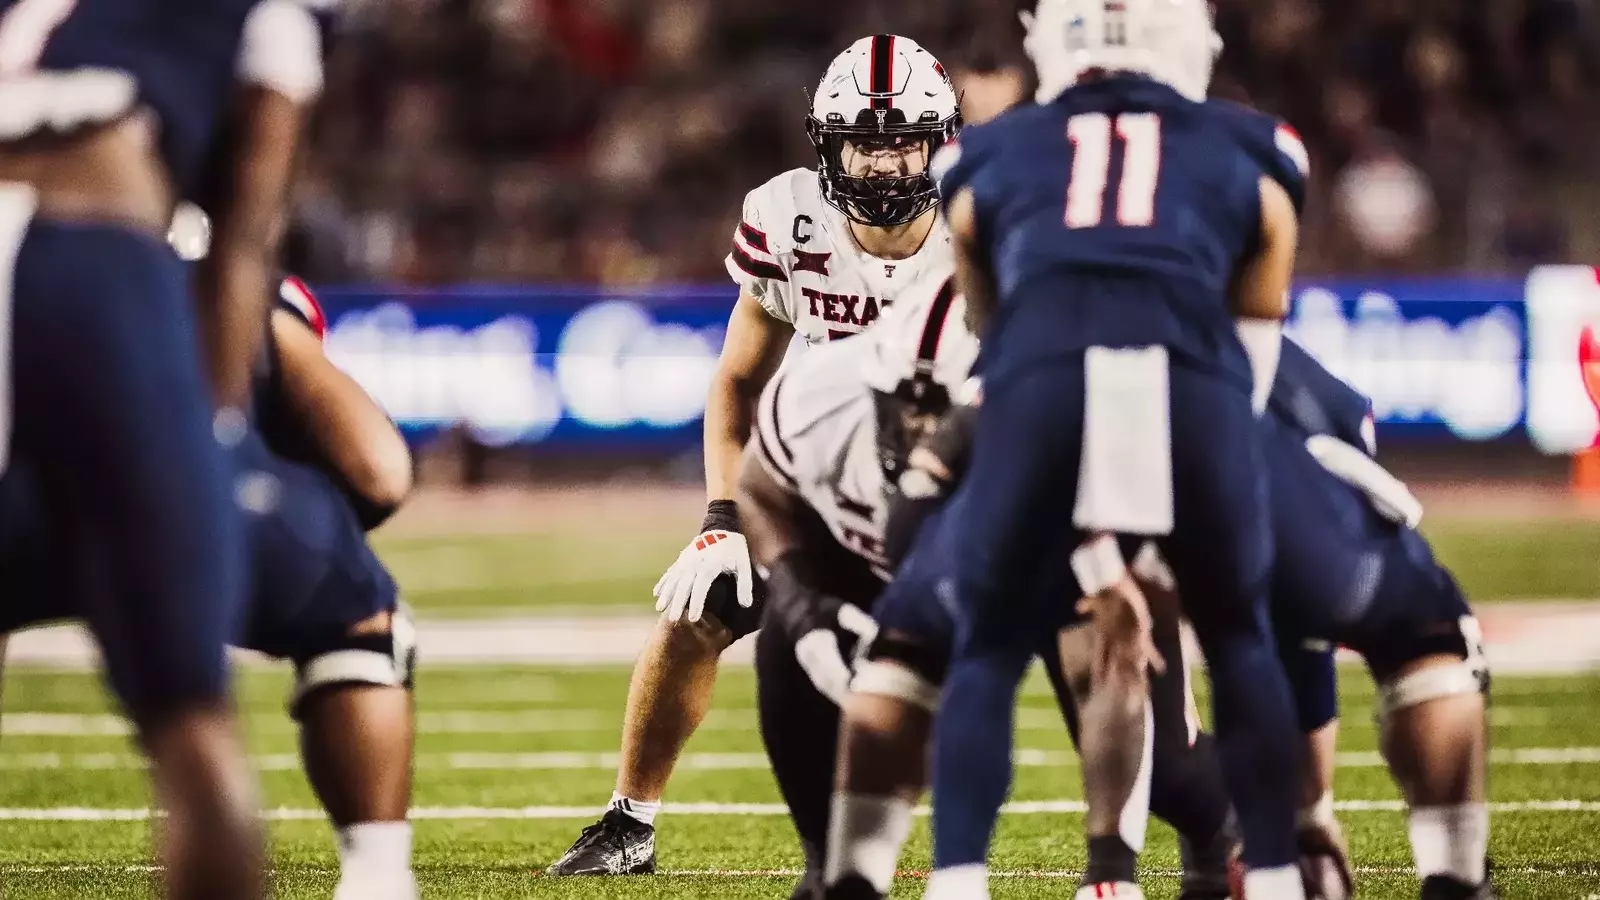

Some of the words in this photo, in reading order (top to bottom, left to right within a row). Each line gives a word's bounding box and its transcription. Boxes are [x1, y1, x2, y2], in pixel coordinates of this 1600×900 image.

[1063, 111, 1162, 229] 11
[792, 214, 813, 244] C
[801, 286, 894, 327] TEXA
